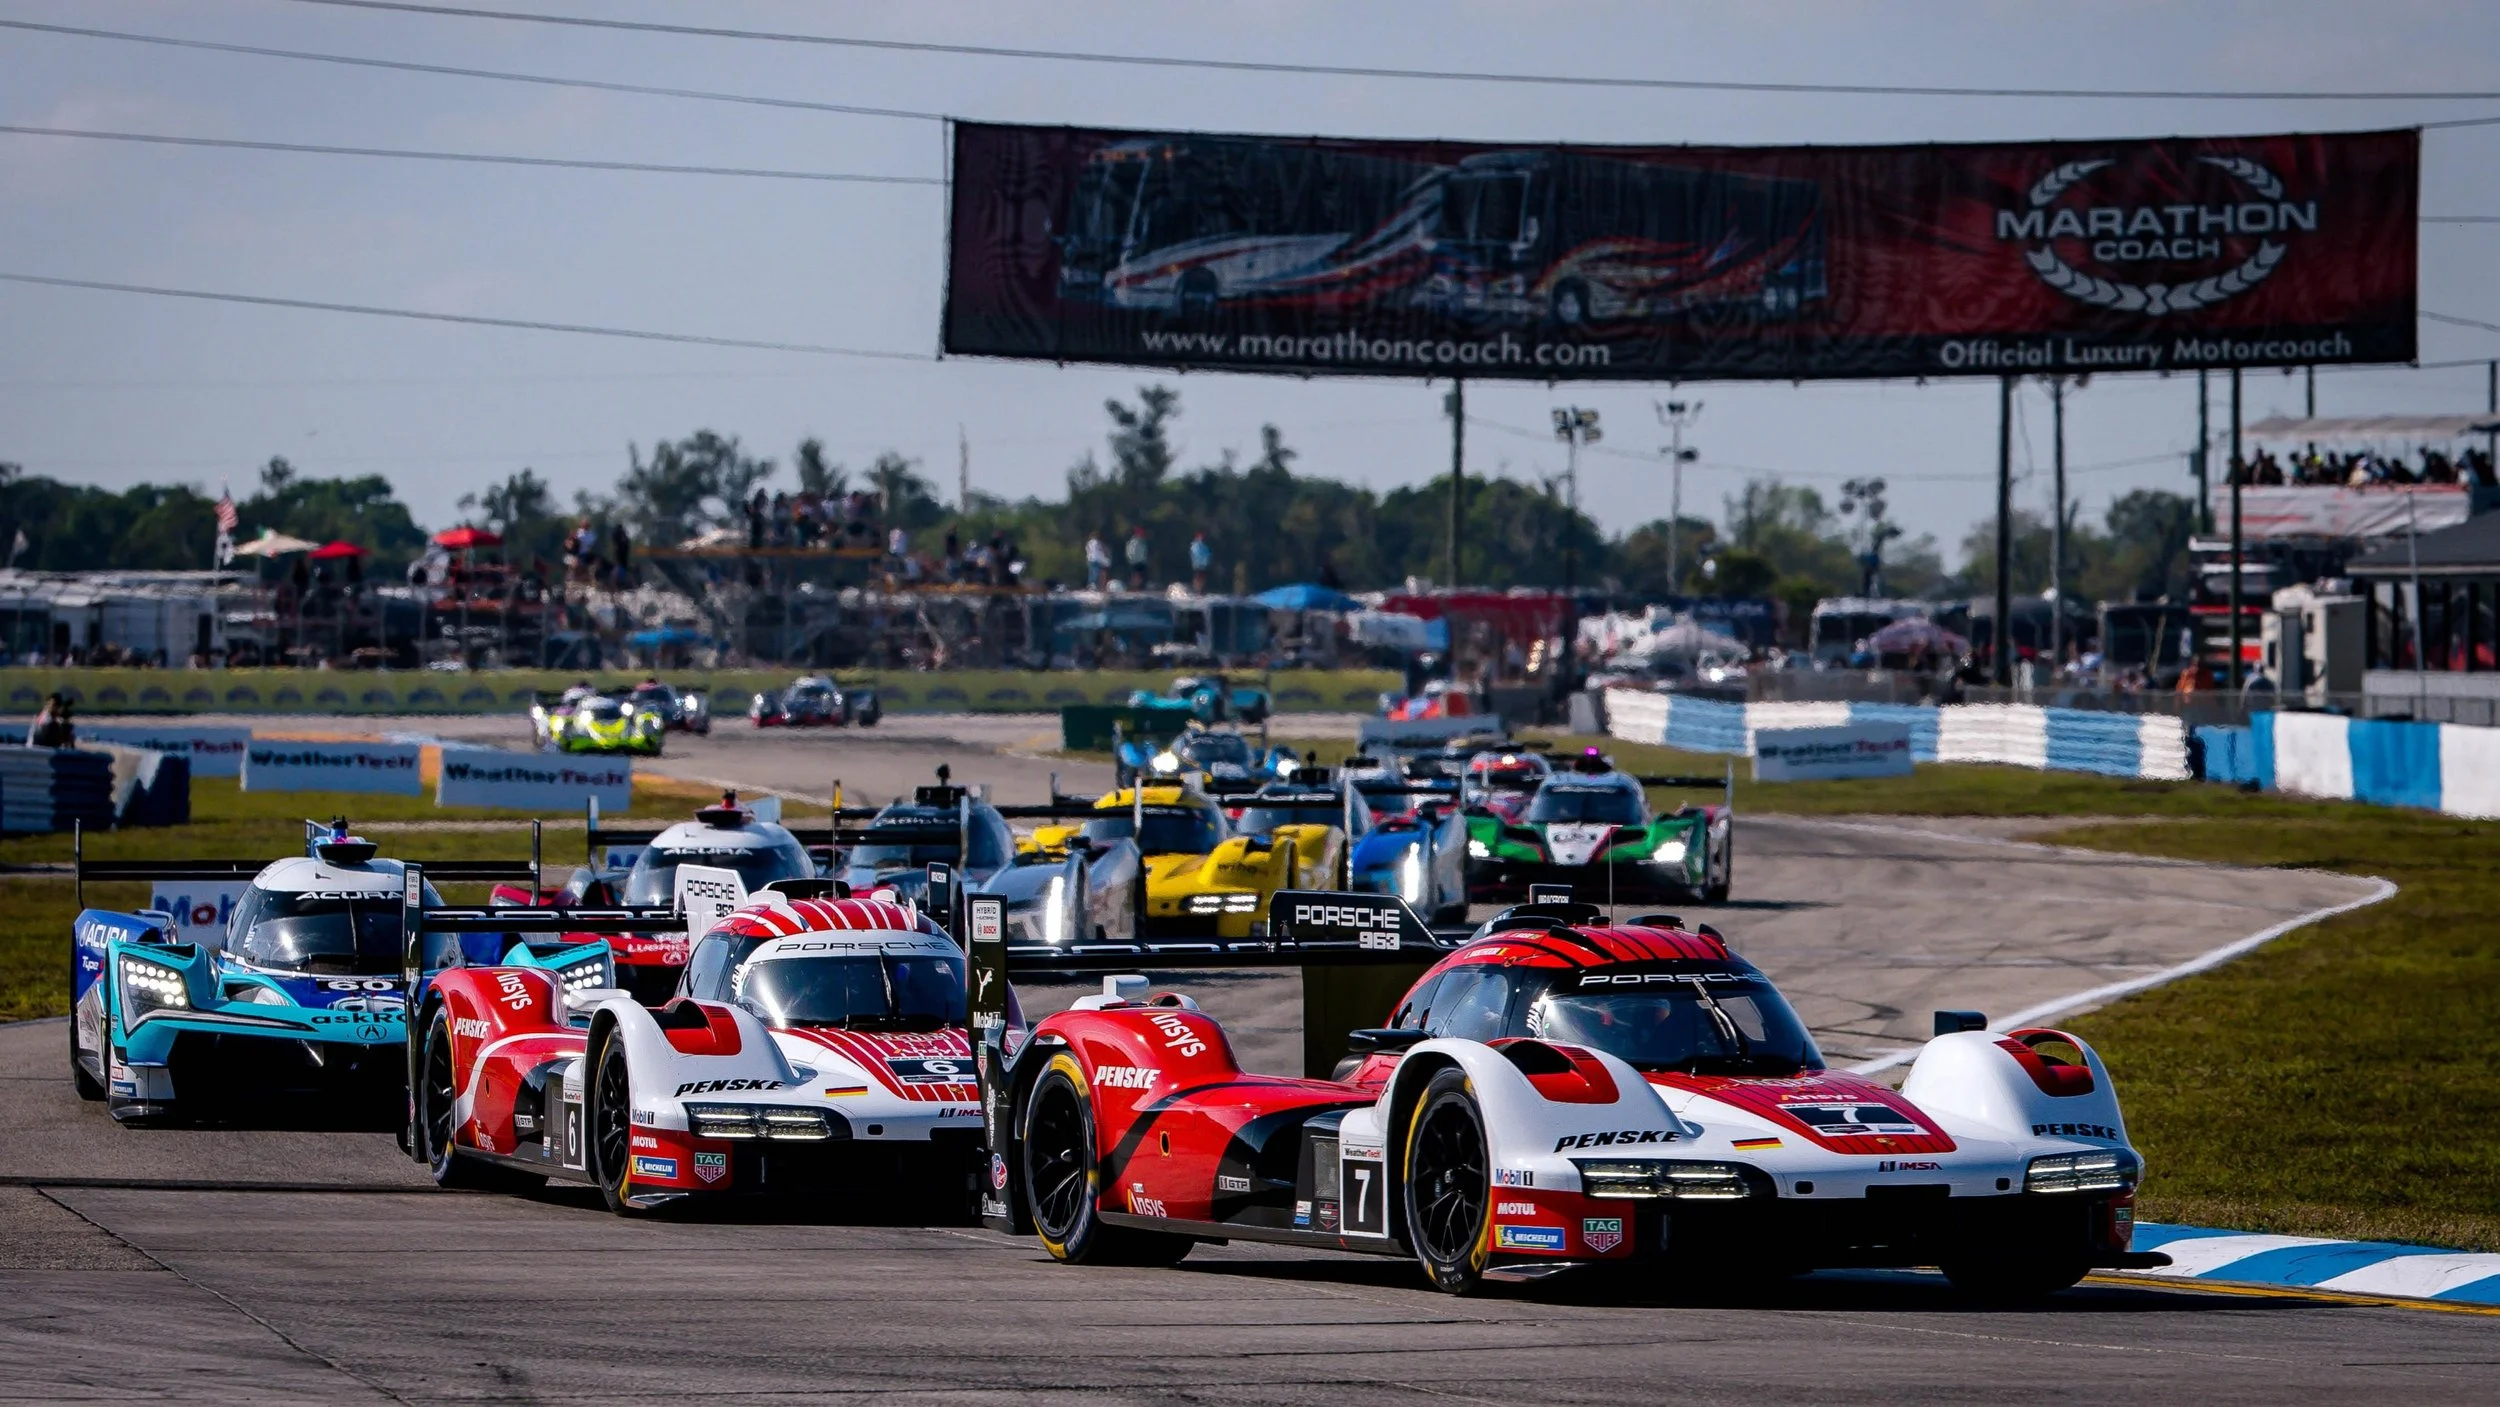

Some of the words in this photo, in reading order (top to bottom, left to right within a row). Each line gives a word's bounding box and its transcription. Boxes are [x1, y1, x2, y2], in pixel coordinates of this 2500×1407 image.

[1997, 201, 2318, 239] MARATHON
[2093, 239, 2220, 262] COACH
[1142, 328, 1611, 366] www.marathoncoach.com
[1940, 340, 2053, 368] Official
[2065, 339, 2162, 368] Luxury
[2173, 332, 2352, 361] Motorcoach
[250, 751, 413, 769] WeatherTech
[446, 763, 624, 785] WeatherTech
[296, 890, 404, 900] ACURA
[687, 880, 735, 901] PORSCHE
[154, 893, 237, 928] Mob
[1295, 905, 1400, 928] PORSCHE
[85, 923, 128, 949] ACURA
[1359, 931, 1400, 950] 963
[776, 942, 950, 952] PORSCHE
[328, 981, 394, 991] 60
[1579, 973, 1769, 986] PORSCHE
[453, 1017, 491, 1039] PENSKE
[1141, 1012, 1206, 1057] Ansys
[922, 1060, 960, 1074] 6
[1092, 1065, 1161, 1089] PENSKE
[674, 1079, 786, 1098] PENSKE
[631, 1109, 647, 1122] Mobil
[957, 1109, 983, 1117] IMS
[1818, 1107, 1861, 1123] 7
[568, 1110, 577, 1157] 6
[2032, 1123, 2118, 1141] PENSKE
[632, 1136, 658, 1148] MOTUL
[1553, 1131, 1684, 1153] PENSKE
[644, 1163, 673, 1172] MICHELIN
[697, 1155, 723, 1165] TAG
[1899, 1162, 1943, 1171] IMSA
[696, 1167, 724, 1180] HEUER
[1495, 1169, 1522, 1186] Mobil
[1523, 1170, 1534, 1187] 1
[1355, 1169, 1371, 1222] 7
[1497, 1203, 1537, 1216] MOTUL
[1587, 1220, 1619, 1231] TAG
[1515, 1233, 1558, 1244] MICHELIN
[1585, 1234, 1620, 1249] HEUER
